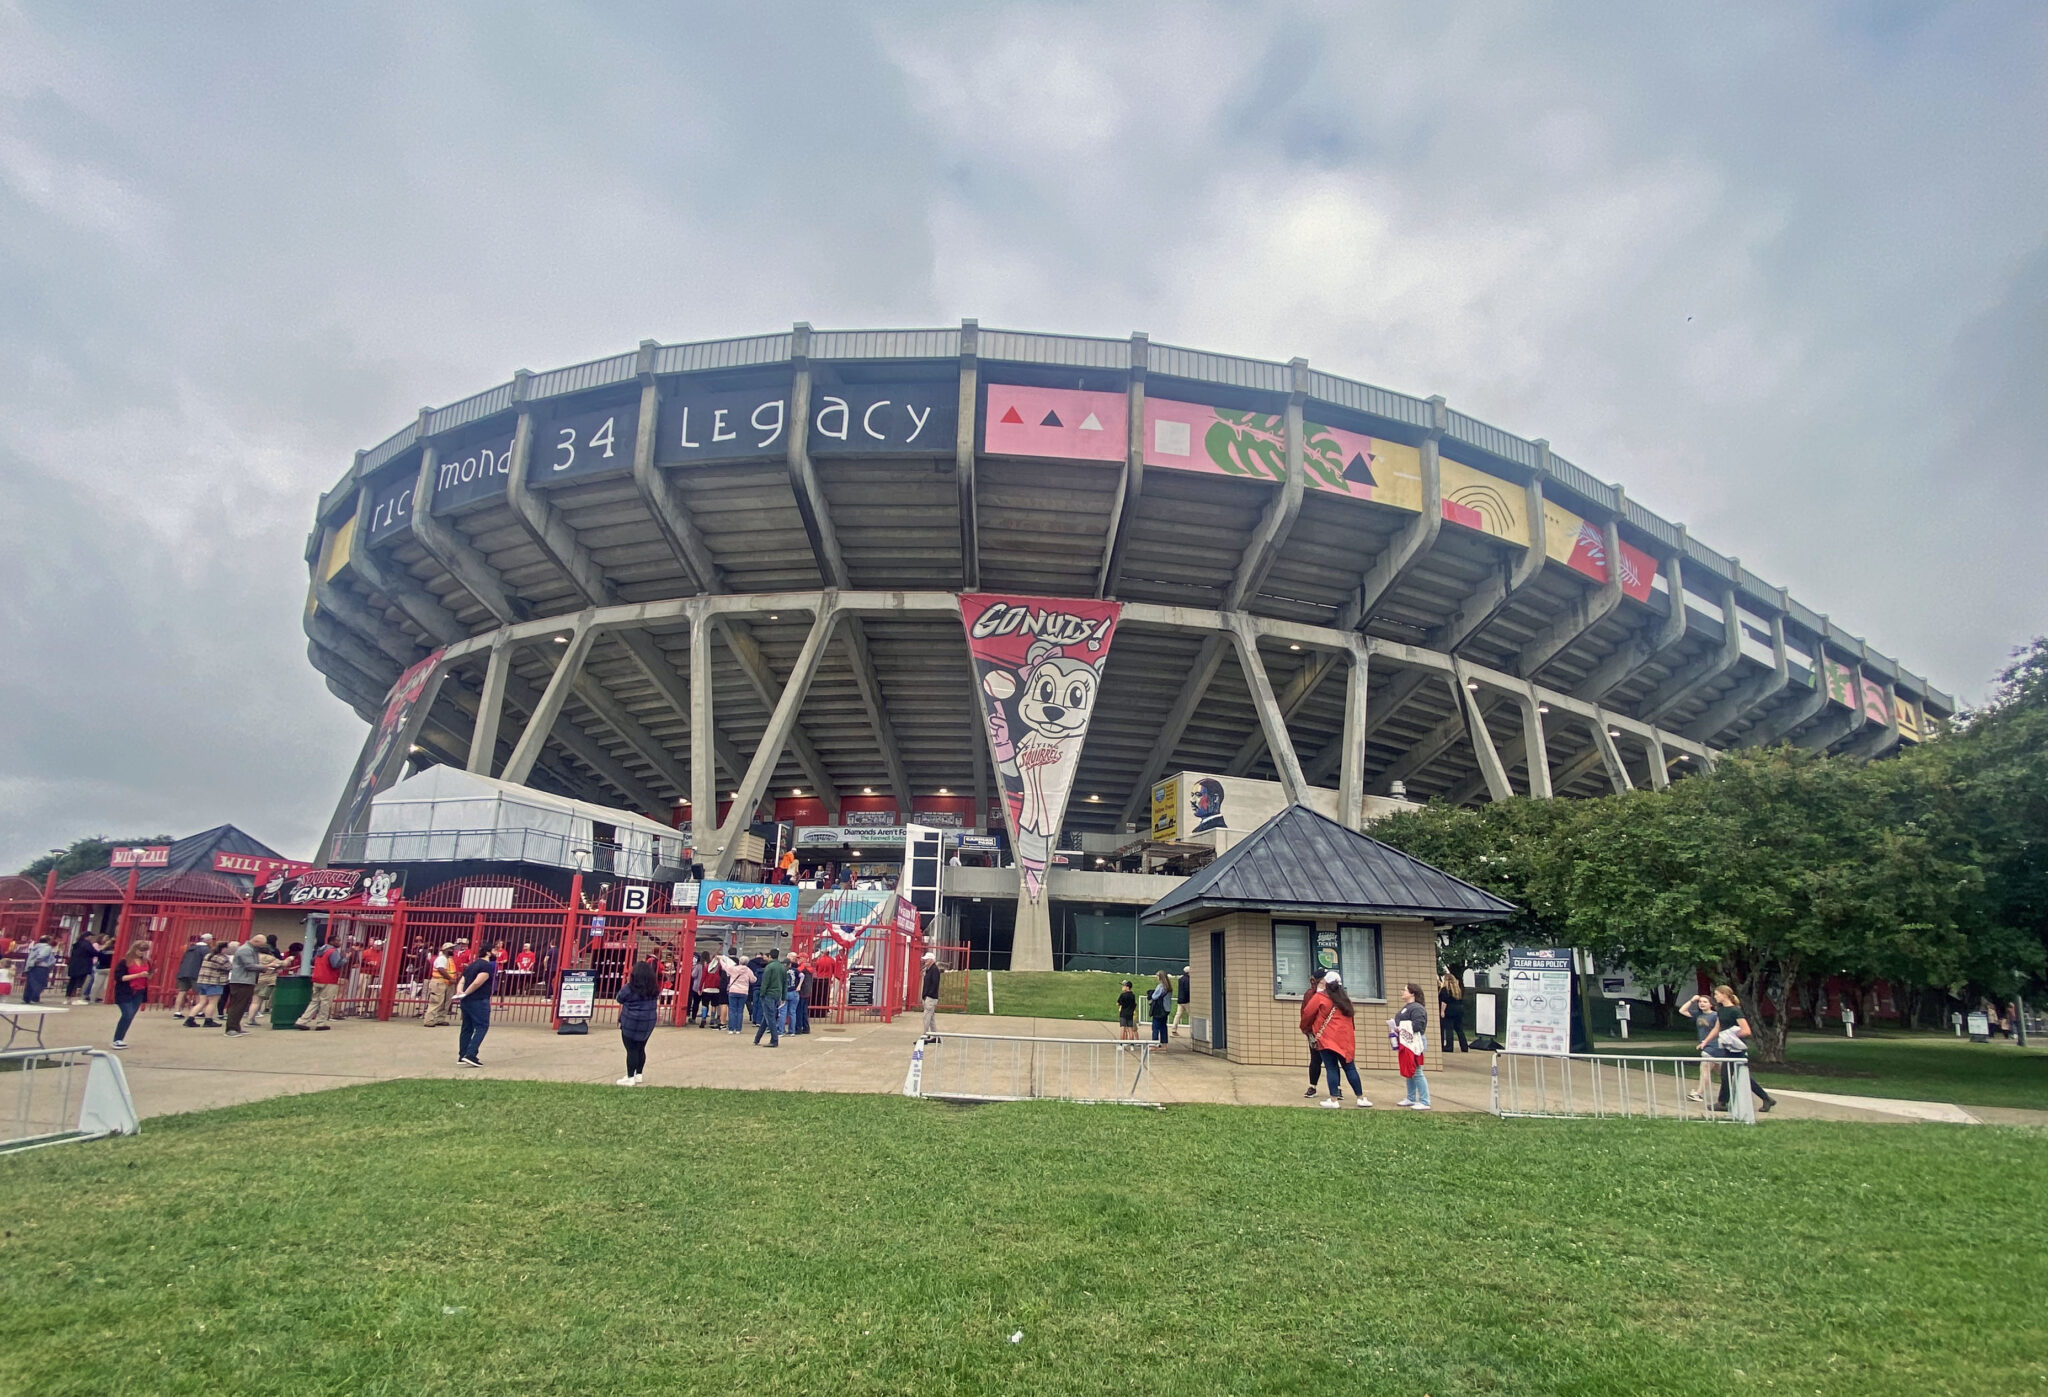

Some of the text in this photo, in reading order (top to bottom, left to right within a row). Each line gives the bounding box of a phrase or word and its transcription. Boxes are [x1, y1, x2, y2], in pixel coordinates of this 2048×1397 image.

[1019, 748, 1063, 771] SQUIRRELS
[293, 887, 350, 903] GATES
[626, 889, 645, 909] B
[1514, 959, 1568, 968] CLEAR BAG POLICY
